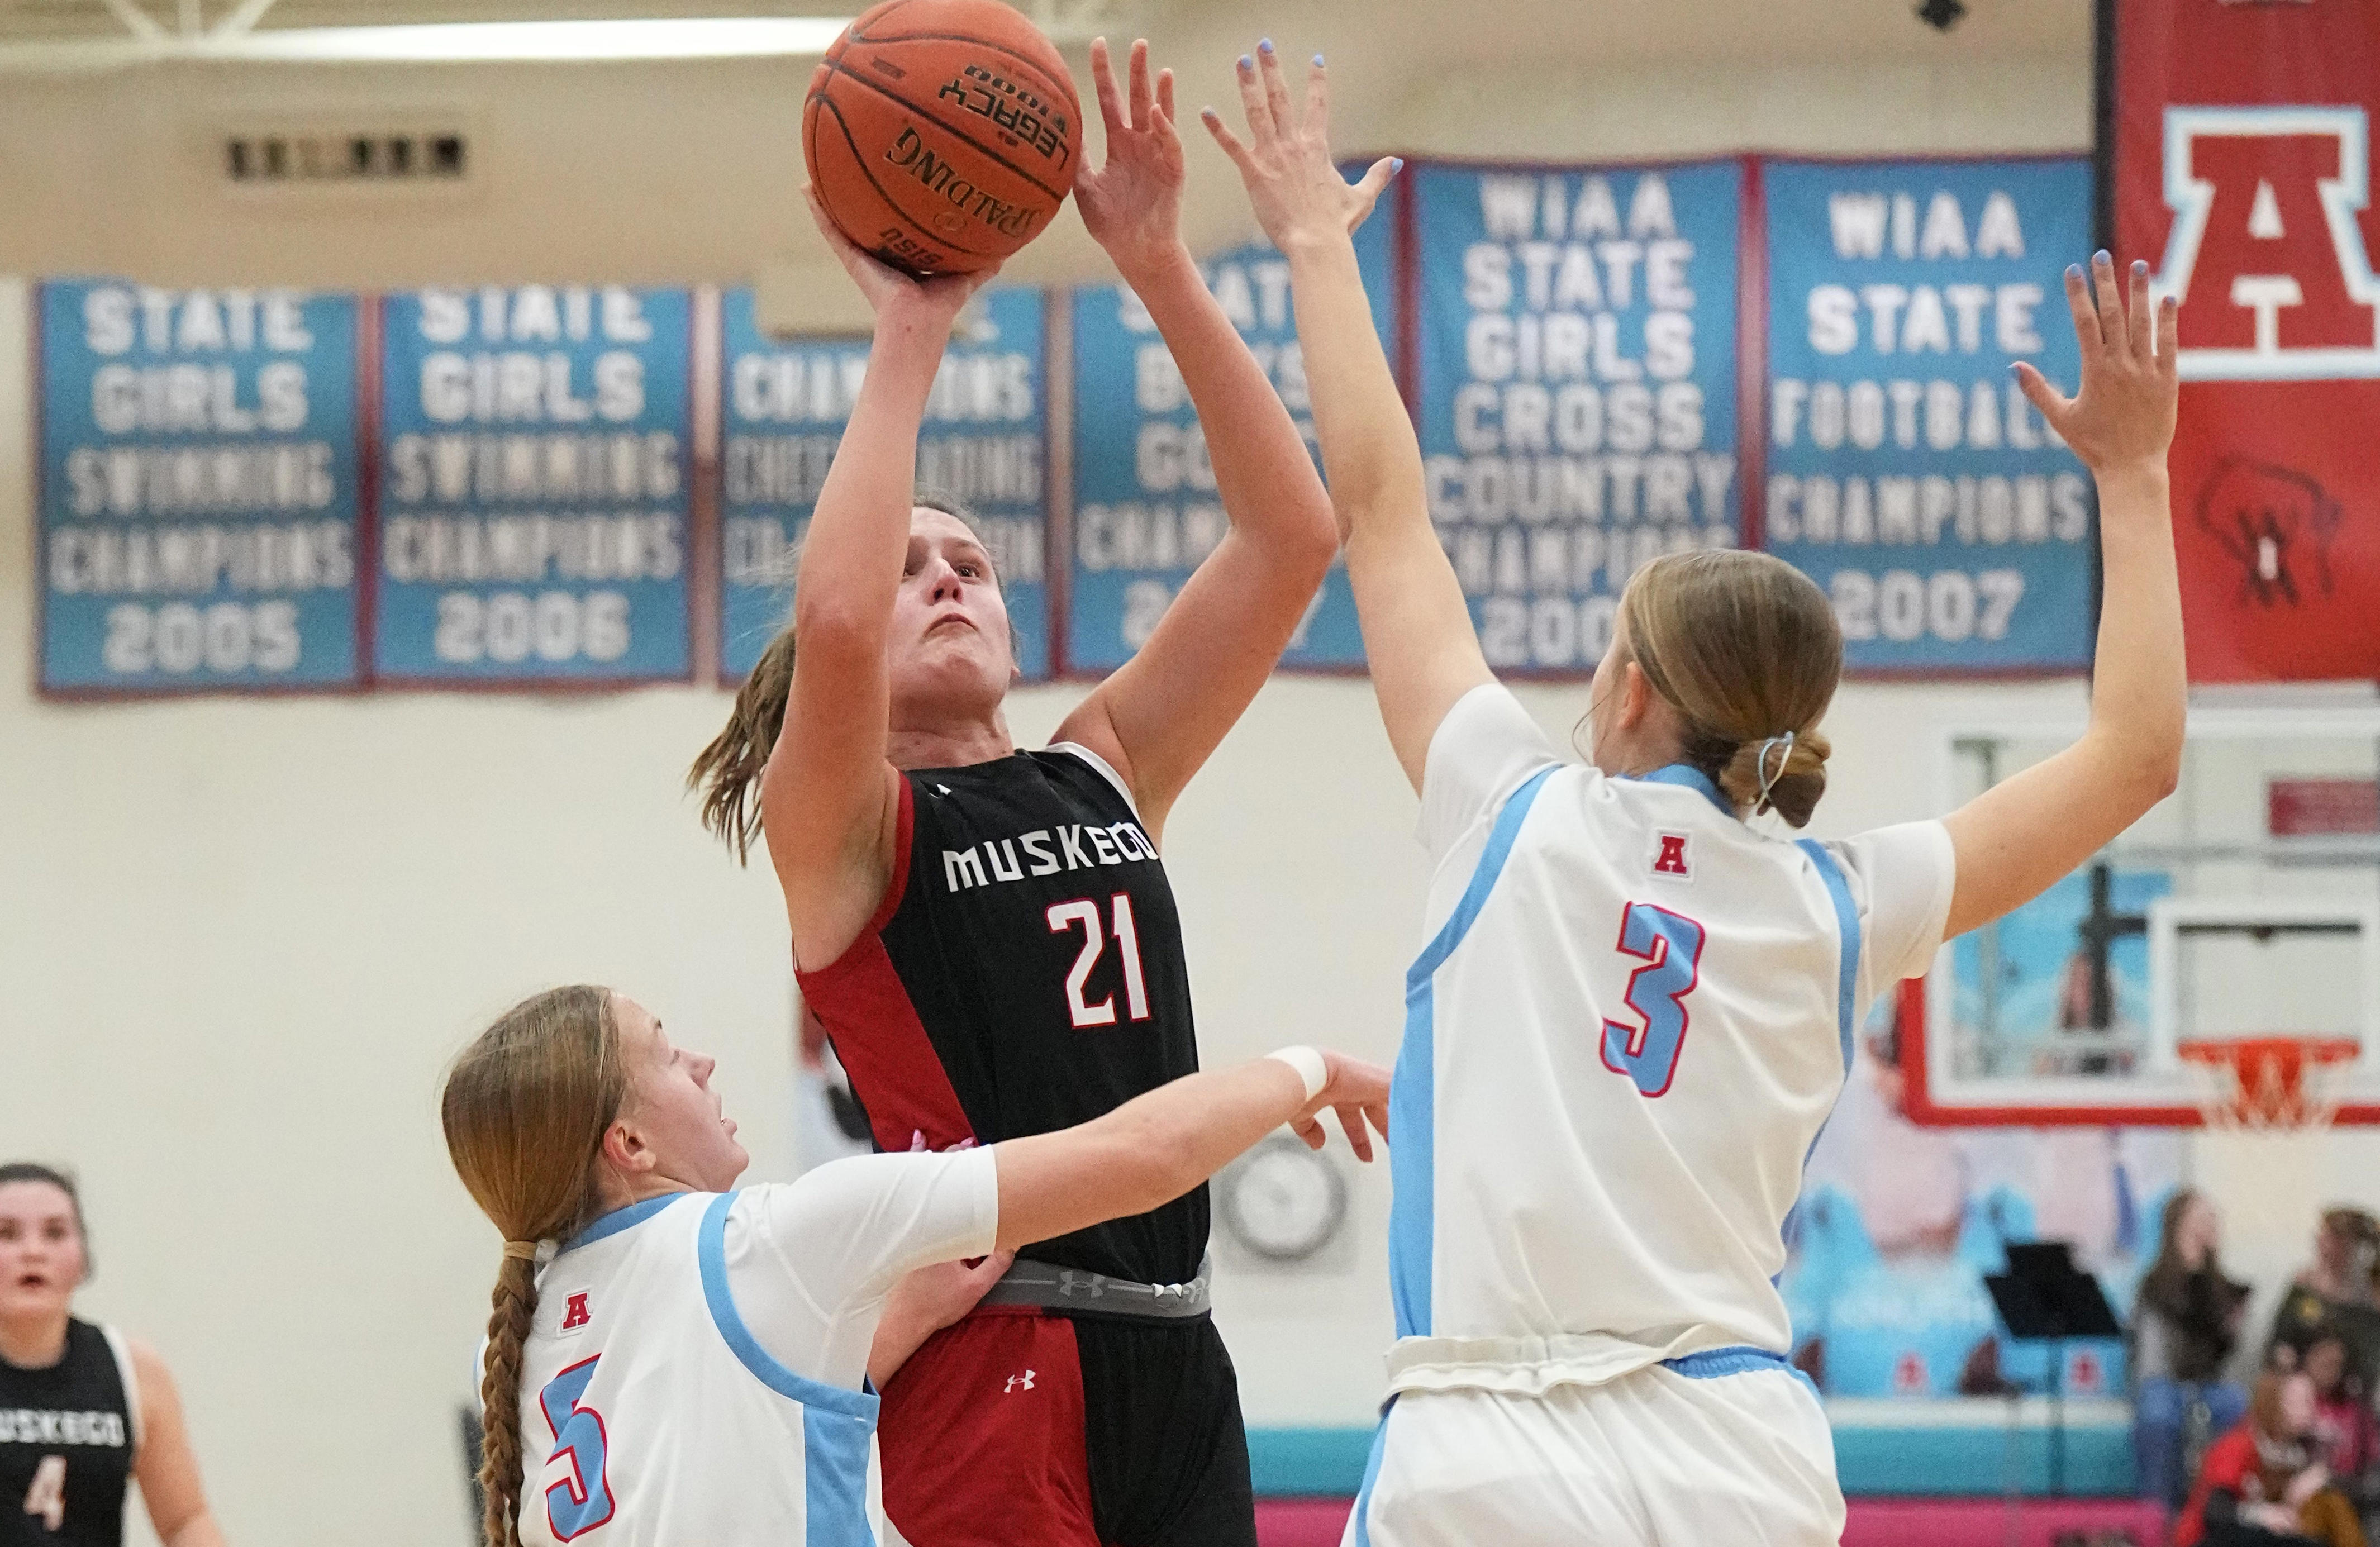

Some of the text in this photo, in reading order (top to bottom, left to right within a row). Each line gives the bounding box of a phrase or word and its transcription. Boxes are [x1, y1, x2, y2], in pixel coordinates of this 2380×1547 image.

[939, 79, 1070, 170] LEGACY
[884, 126, 1043, 239] SPALDING
[1479, 173, 1678, 240] WIAA
[1828, 190, 2026, 260] WIAA
[2150, 104, 2380, 382] A
[1463, 240, 1696, 311] STATE
[83, 287, 314, 356] STATE
[419, 284, 653, 344] STATE
[1466, 310, 1695, 383] GIRLS
[1807, 284, 2045, 356] STATE
[91, 361, 308, 434] GIRLS
[420, 351, 646, 423] GIRLS
[1456, 381, 1705, 454] CROSS
[1425, 454, 1738, 524] COUNTRY
[1765, 473, 2091, 546] CHAMPIONS
[49, 518, 356, 594] CHAMPIONS
[383, 512, 684, 584] CHAMPIONS
[102, 601, 302, 673] 2005
[1481, 595, 1620, 668] 200
[1829, 569, 2025, 642] 2007
[942, 822, 1159, 893] MUSKEGO
[1654, 834, 1688, 875] A
[1045, 892, 1151, 1030] 21
[1599, 900, 1706, 1098] 3
[562, 1292, 592, 1330] A
[540, 1352, 616, 1544] 5
[23, 1454, 68, 1532] 4
